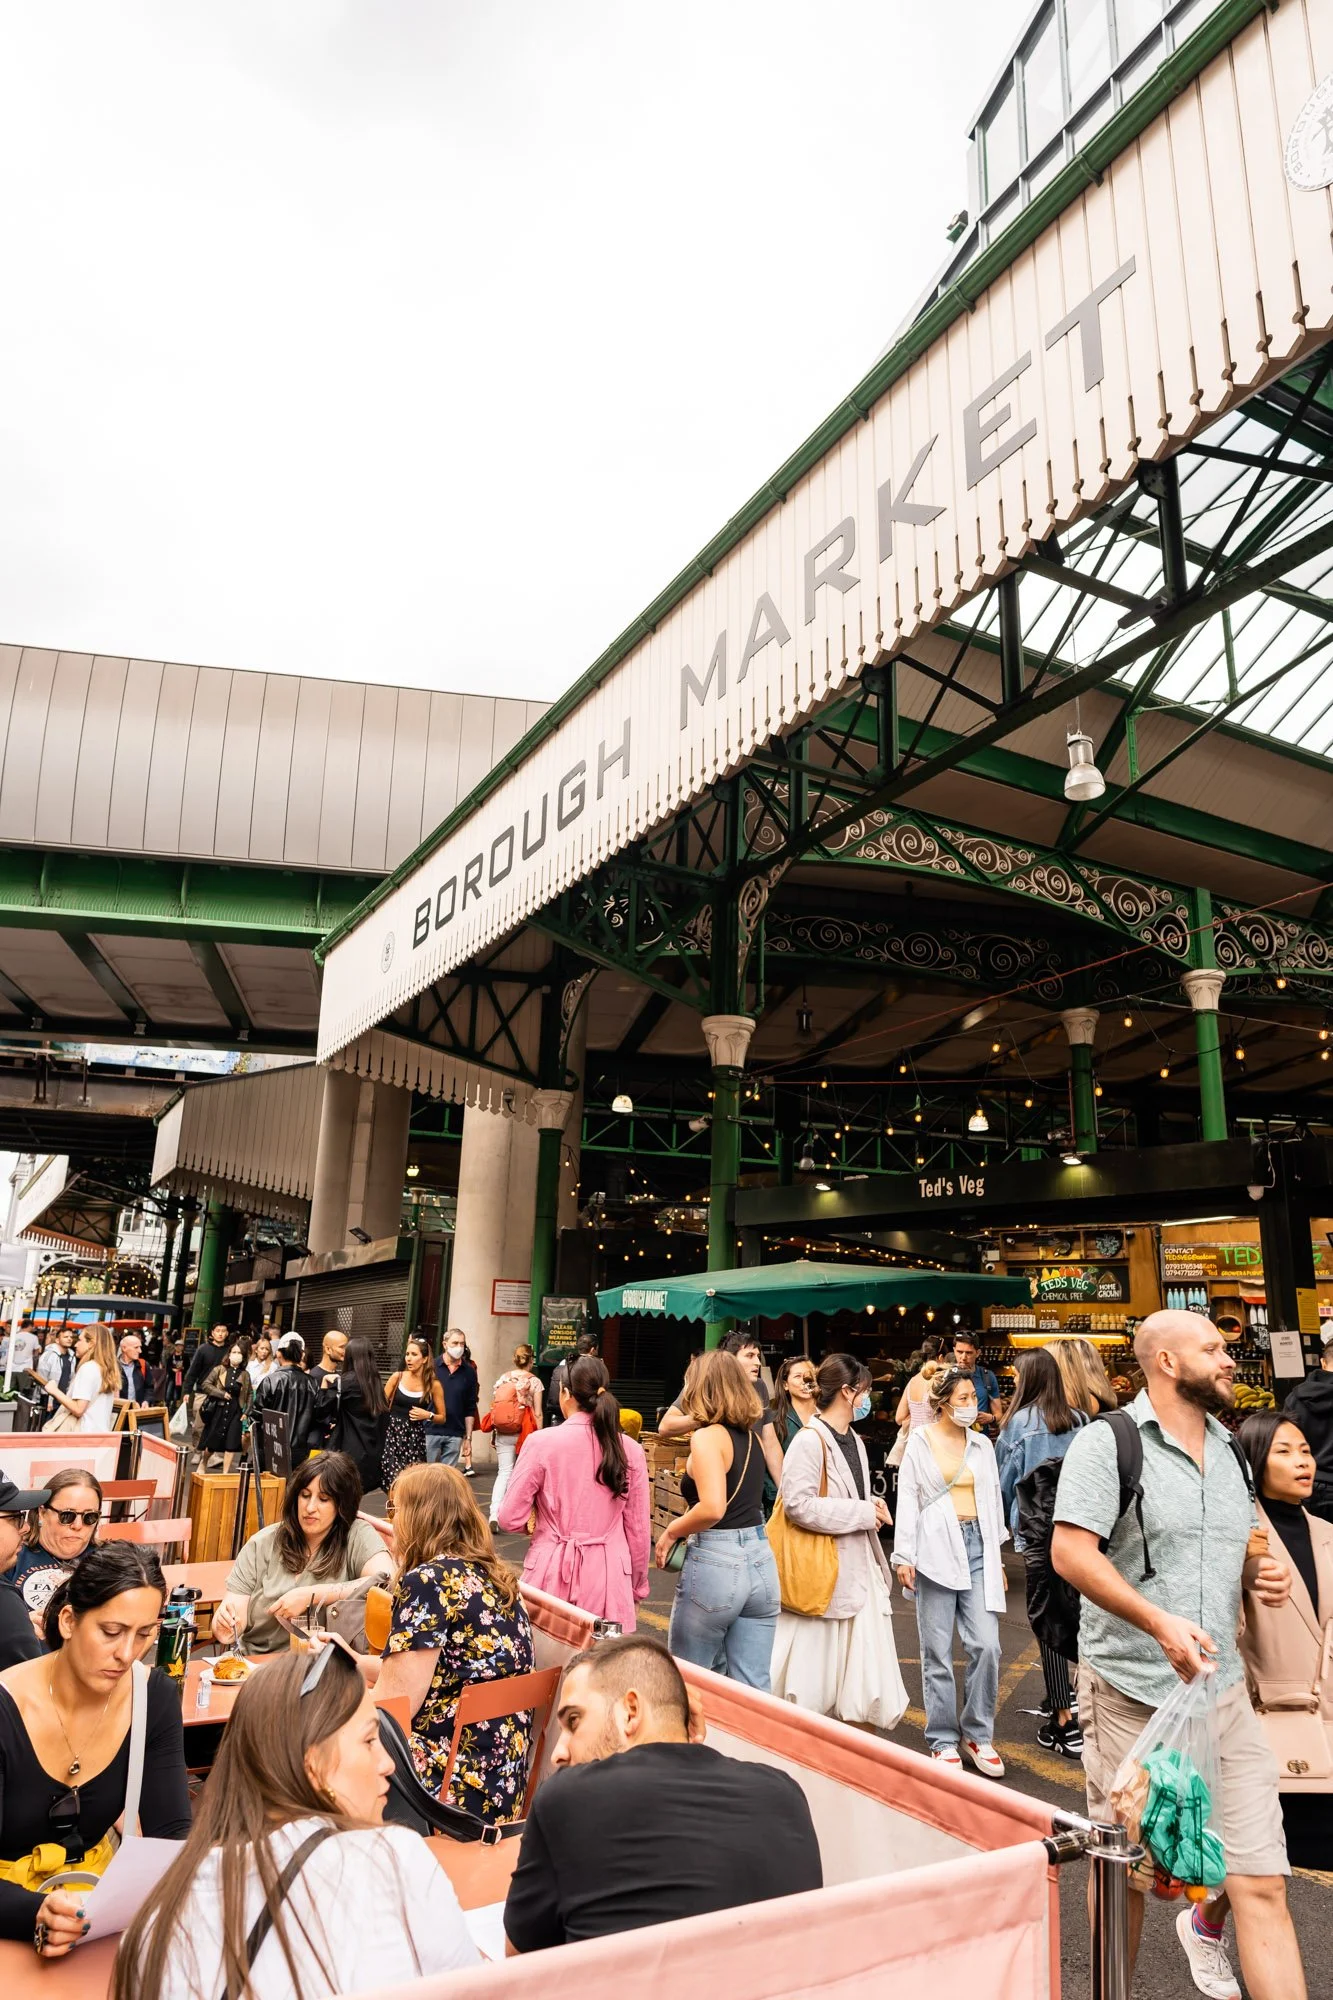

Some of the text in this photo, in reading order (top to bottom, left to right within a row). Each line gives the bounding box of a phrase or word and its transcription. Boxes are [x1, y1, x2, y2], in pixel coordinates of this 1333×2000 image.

[412, 254, 1136, 950] BOROUGH MARKET
[918, 1175, 985, 1198] Ted's Veg
[1219, 1246, 1263, 1265] TED'
[1041, 1276, 1089, 1291] TED'S VEG
[1041, 1292, 1084, 1301] CHEMICAL FREE
